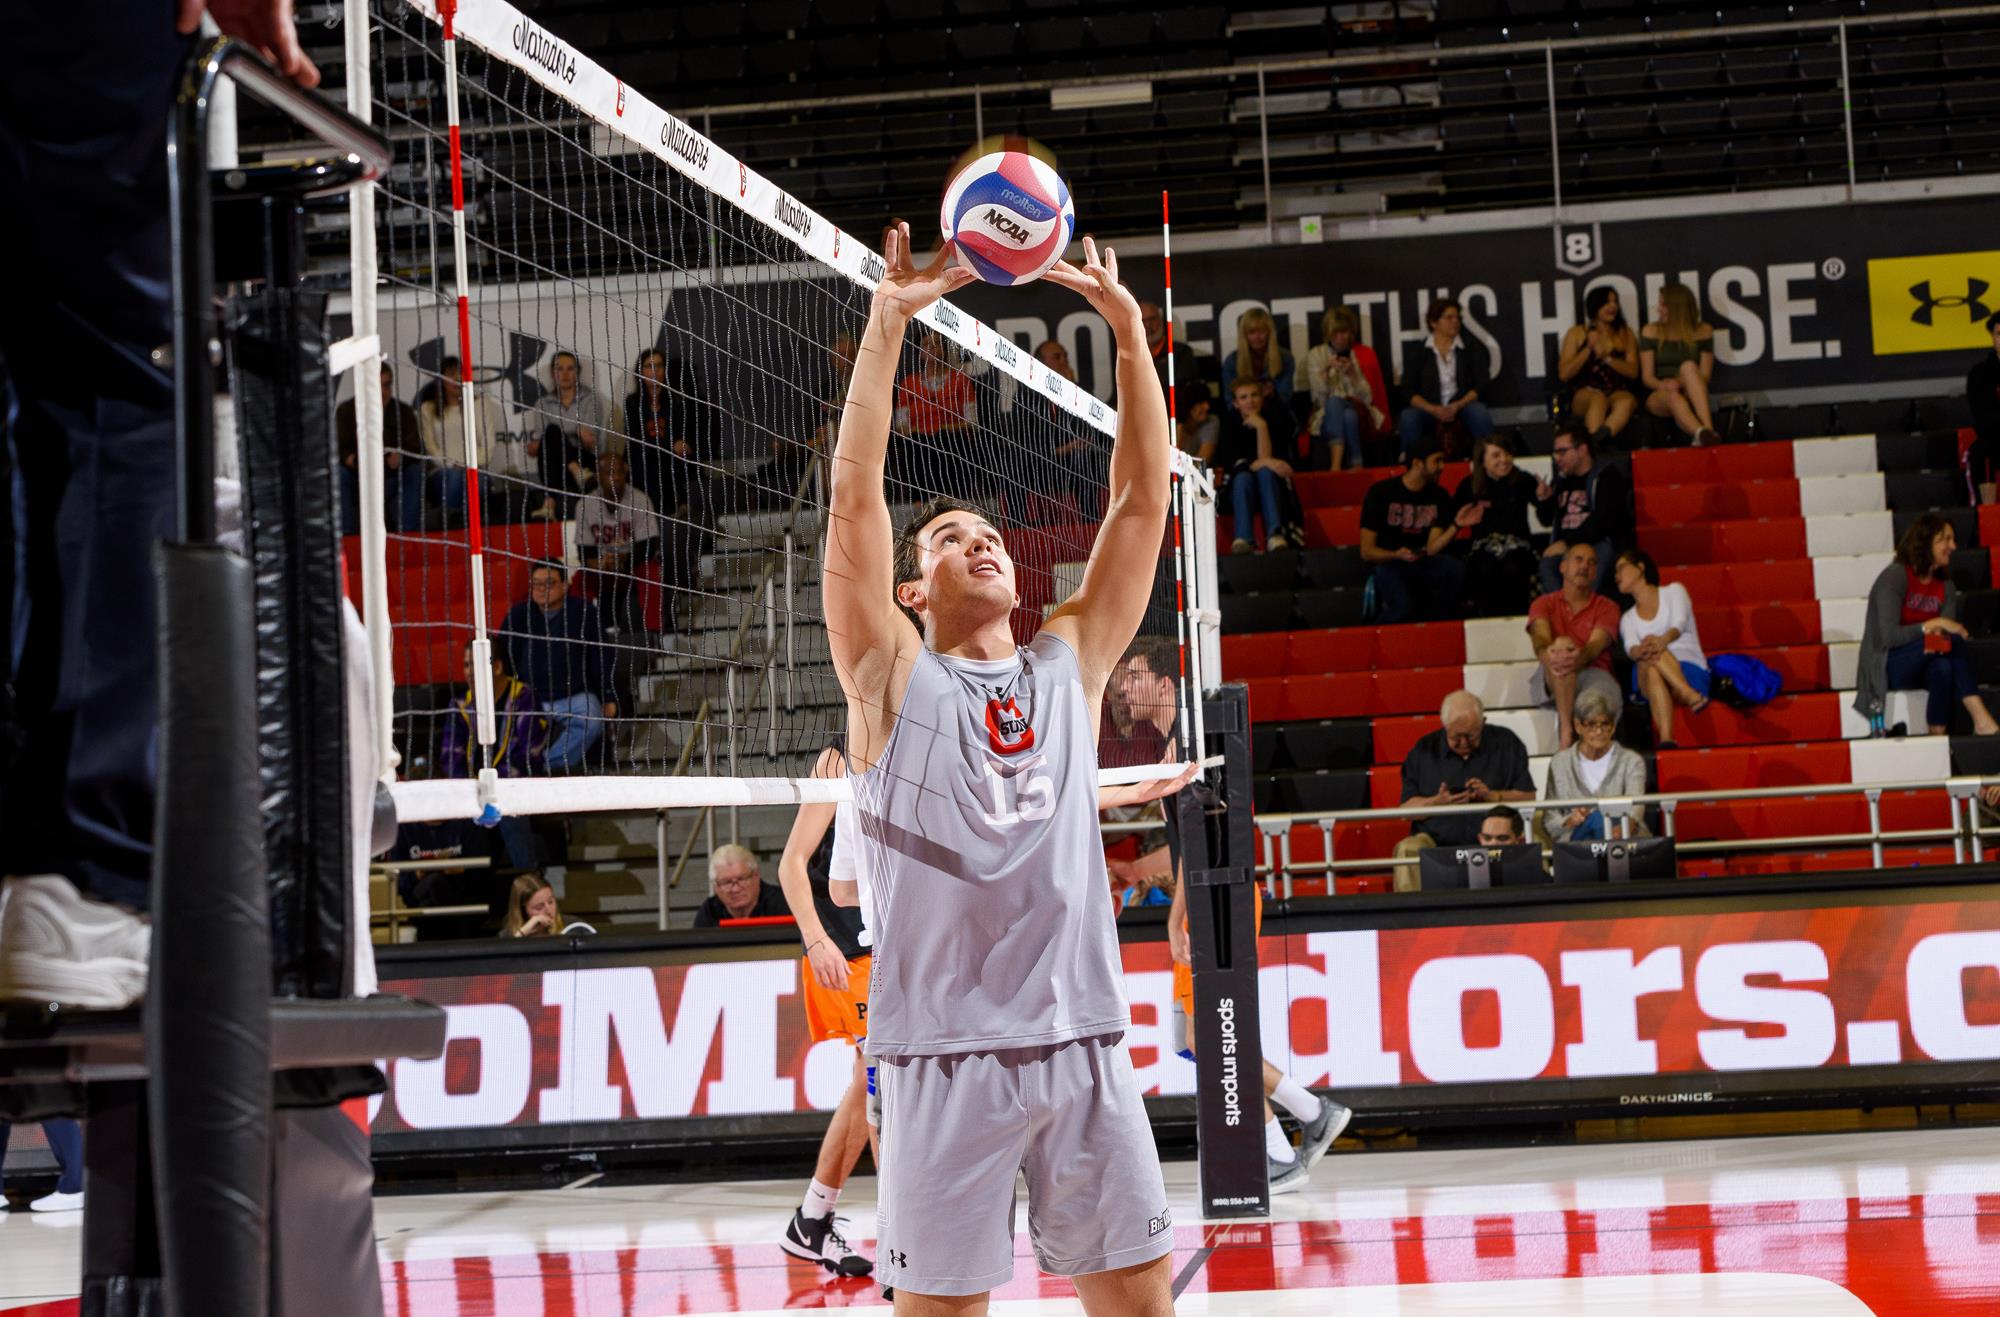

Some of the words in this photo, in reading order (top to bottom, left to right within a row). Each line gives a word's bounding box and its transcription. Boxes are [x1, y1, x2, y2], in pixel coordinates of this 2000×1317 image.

[1001, 188, 1042, 219] molten
[983, 208, 1031, 246] NCAA
[1564, 232, 1592, 263] 8
[983, 755, 1056, 826] 15
[1217, 998, 1238, 1055] sports
[1221, 1056, 1241, 1127] imports
[1620, 1092, 1713, 1105] DAKTRONICS
